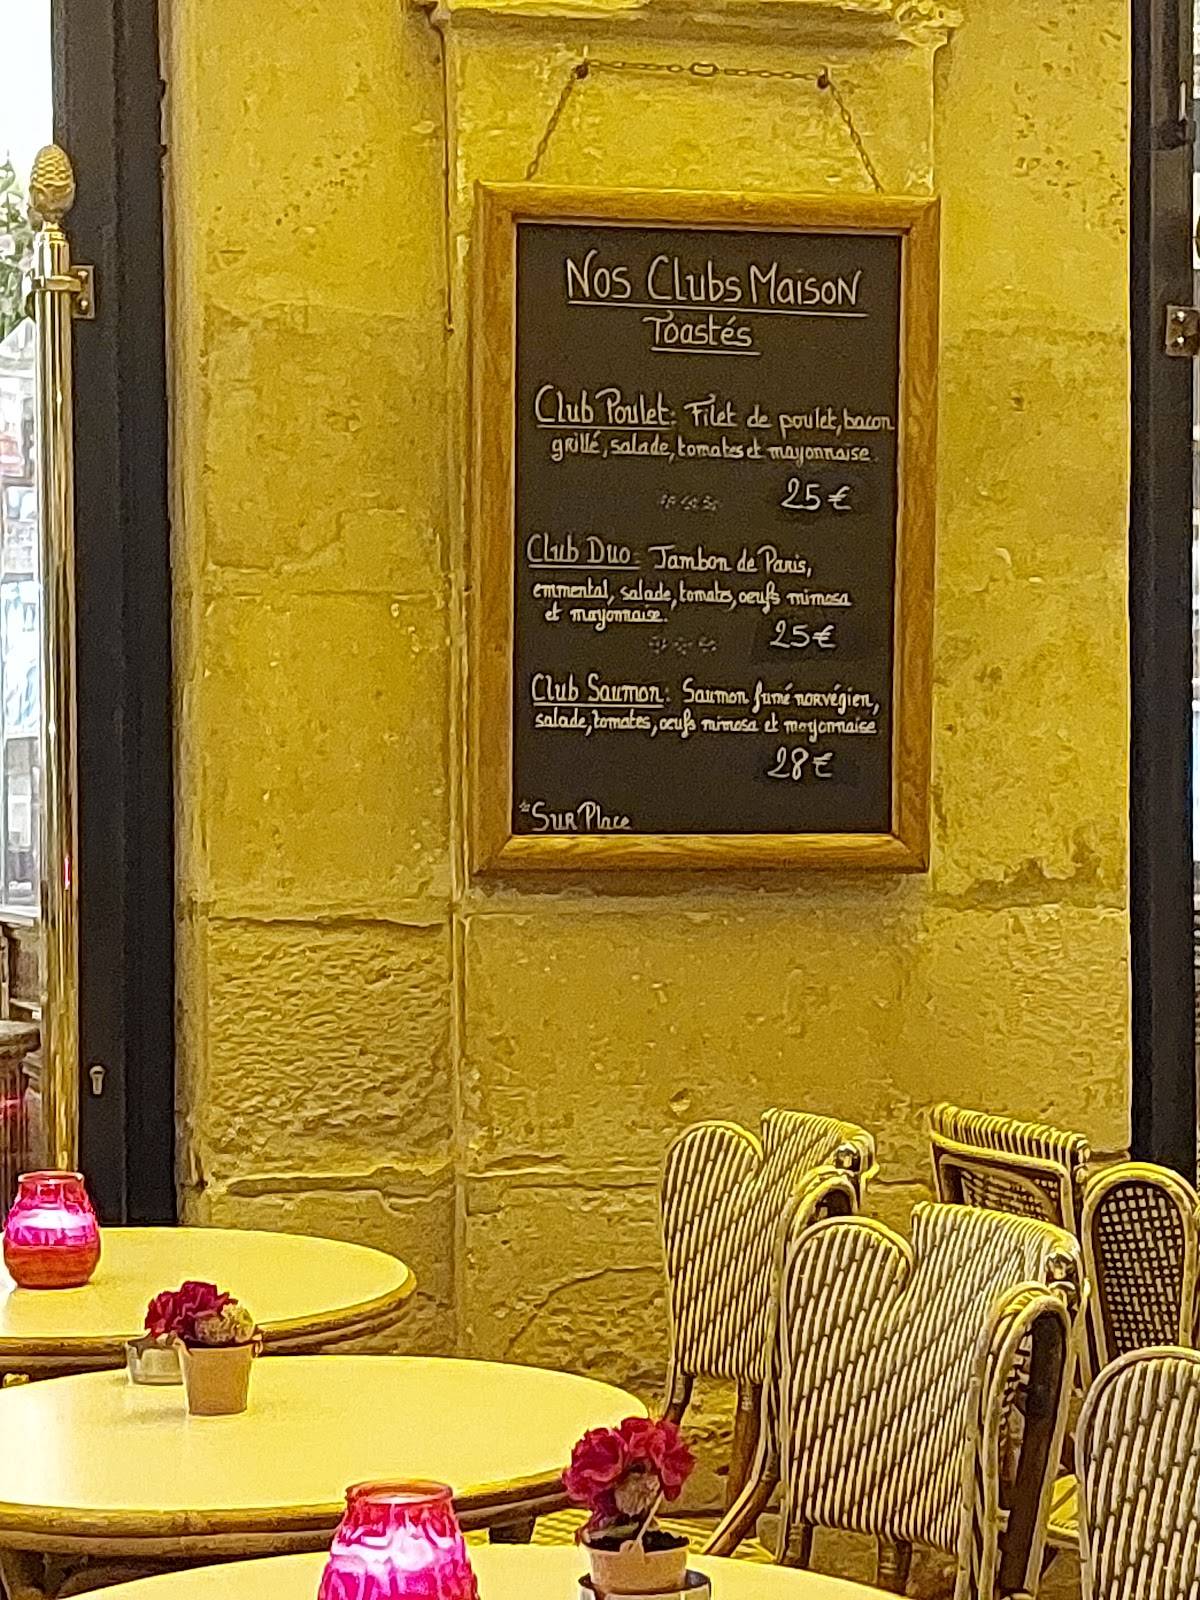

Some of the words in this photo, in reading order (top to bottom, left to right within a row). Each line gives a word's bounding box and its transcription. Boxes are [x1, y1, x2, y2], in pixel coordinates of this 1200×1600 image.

[566, 249, 632, 299] Nos
[648, 255, 742, 303] Clubs
[642, 310, 753, 347] Toastés
[535, 384, 593, 423] Club
[595, 388, 677, 425] Poulet:
[684, 393, 738, 427] Filet
[747, 404, 772, 427] de
[843, 408, 894, 430] bacon
[551, 431, 608, 461] grillé,
[611, 433, 675, 464] salade,
[678, 436, 744, 458] tomates
[747, 438, 765, 459] et
[527, 532, 579, 562] Club
[648, 545, 732, 571] Jambon
[737, 548, 757, 572] de
[757, 545, 812, 578] Paris,
[533, 577, 614, 605] emmental,
[619, 579, 677, 611] salade,
[786, 589, 852, 606] mimosa
[545, 601, 563, 621] et
[532, 673, 579, 701] Club
[588, 673, 671, 703] Saumon:
[682, 677, 749, 704] Saumon
[752, 680, 793, 713] fumé
[794, 683, 880, 715] norvégien,
[535, 707, 592, 737] salade,
[592, 708, 658, 737] tomates,
[701, 715, 759, 732] mimosa
[765, 712, 780, 732] et
[577, 801, 632, 830] Place
